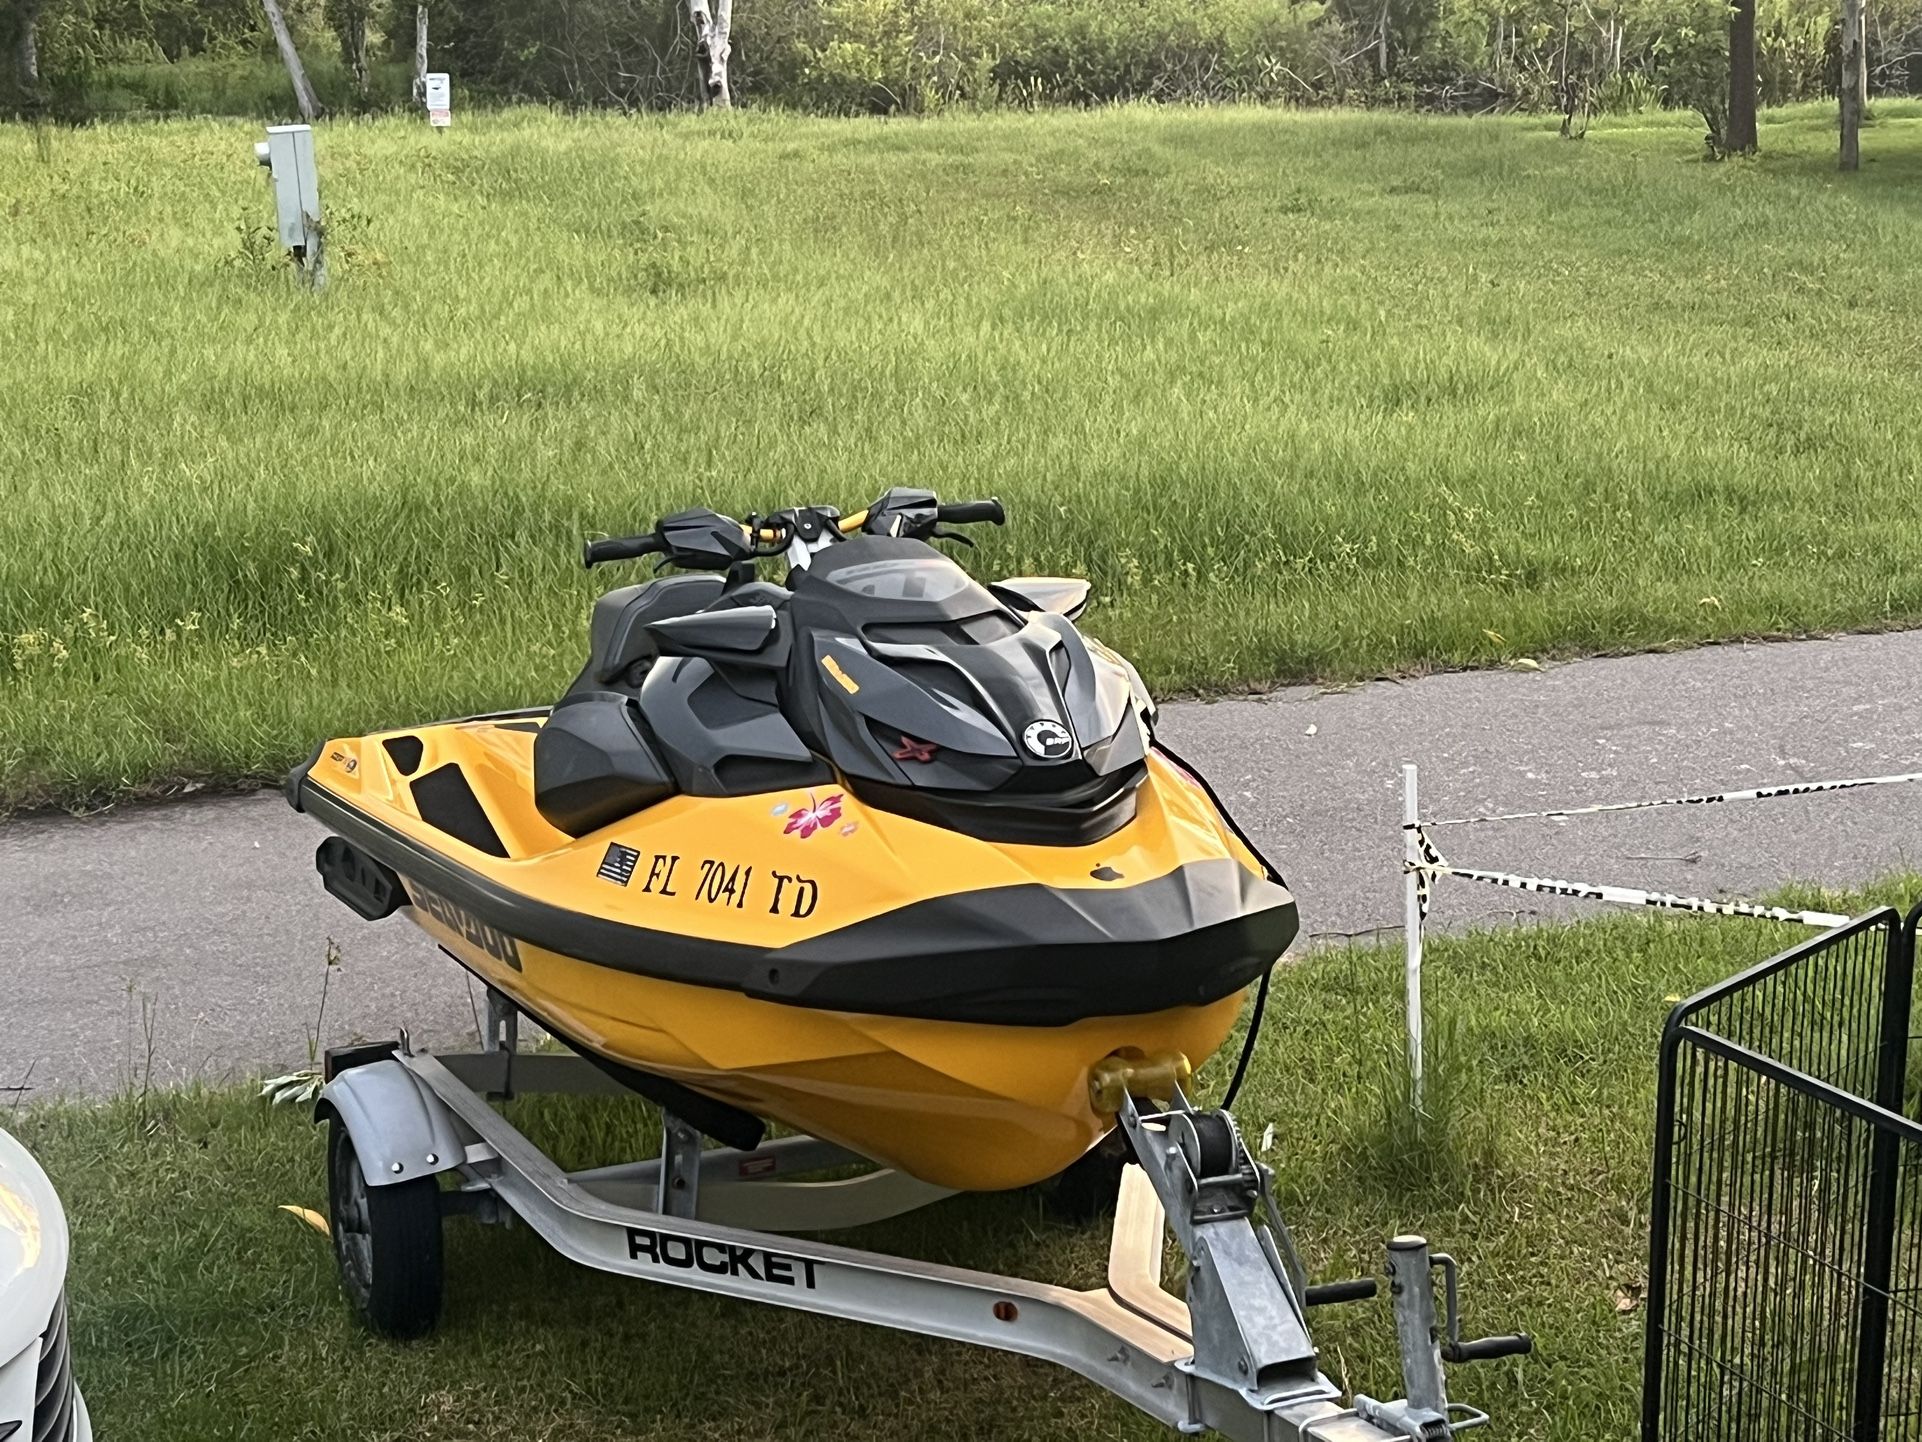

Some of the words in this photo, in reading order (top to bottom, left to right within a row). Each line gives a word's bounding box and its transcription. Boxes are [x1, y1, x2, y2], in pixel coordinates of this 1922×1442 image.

[642, 855, 680, 897] FL
[695, 859, 753, 909] 7041
[769, 870, 818, 919] TD
[626, 1227, 826, 1290] ROCKET
